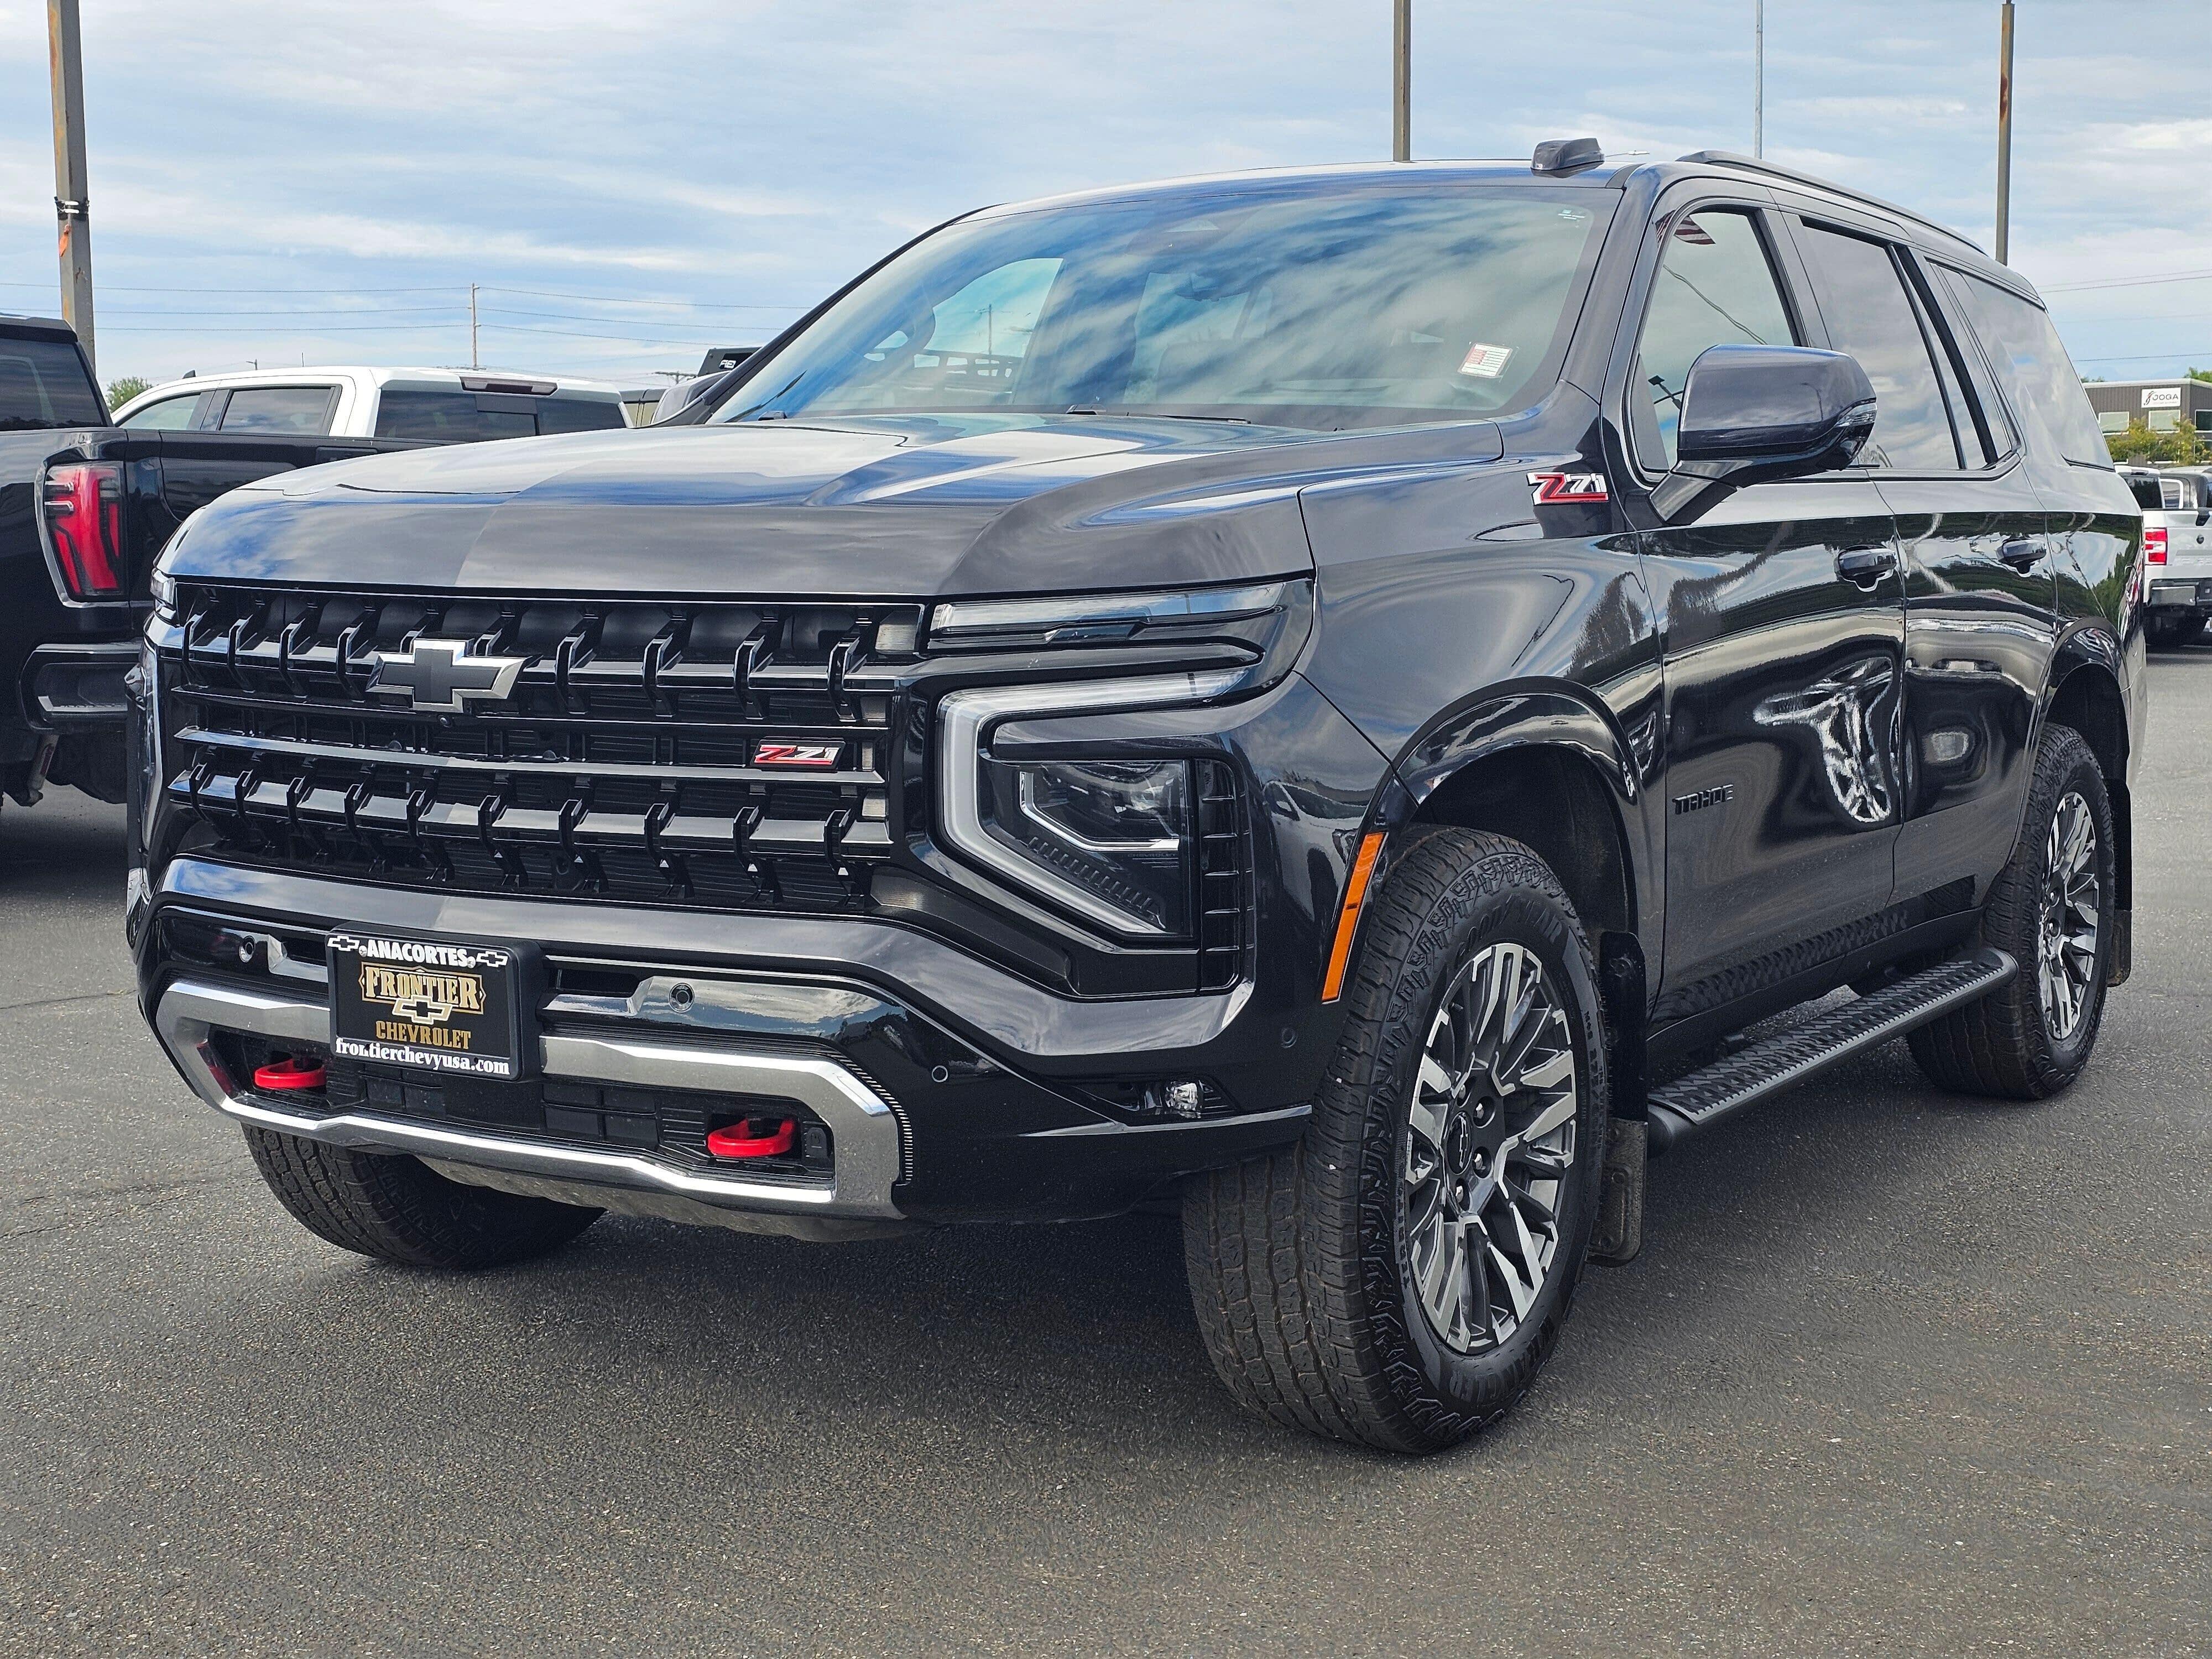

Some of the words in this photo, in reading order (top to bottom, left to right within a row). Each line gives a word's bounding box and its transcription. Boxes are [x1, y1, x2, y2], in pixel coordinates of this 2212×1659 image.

[1526, 472, 1609, 505] Z71
[754, 744, 841, 765] Z71
[1672, 784, 1734, 815] TAHOE
[367, 940, 467, 968] ANACORTES
[365, 966, 481, 1010] FRONTIER
[375, 1020, 471, 1050] CHEVROLET
[336, 1037, 510, 1075] frontierchevyusa.com
